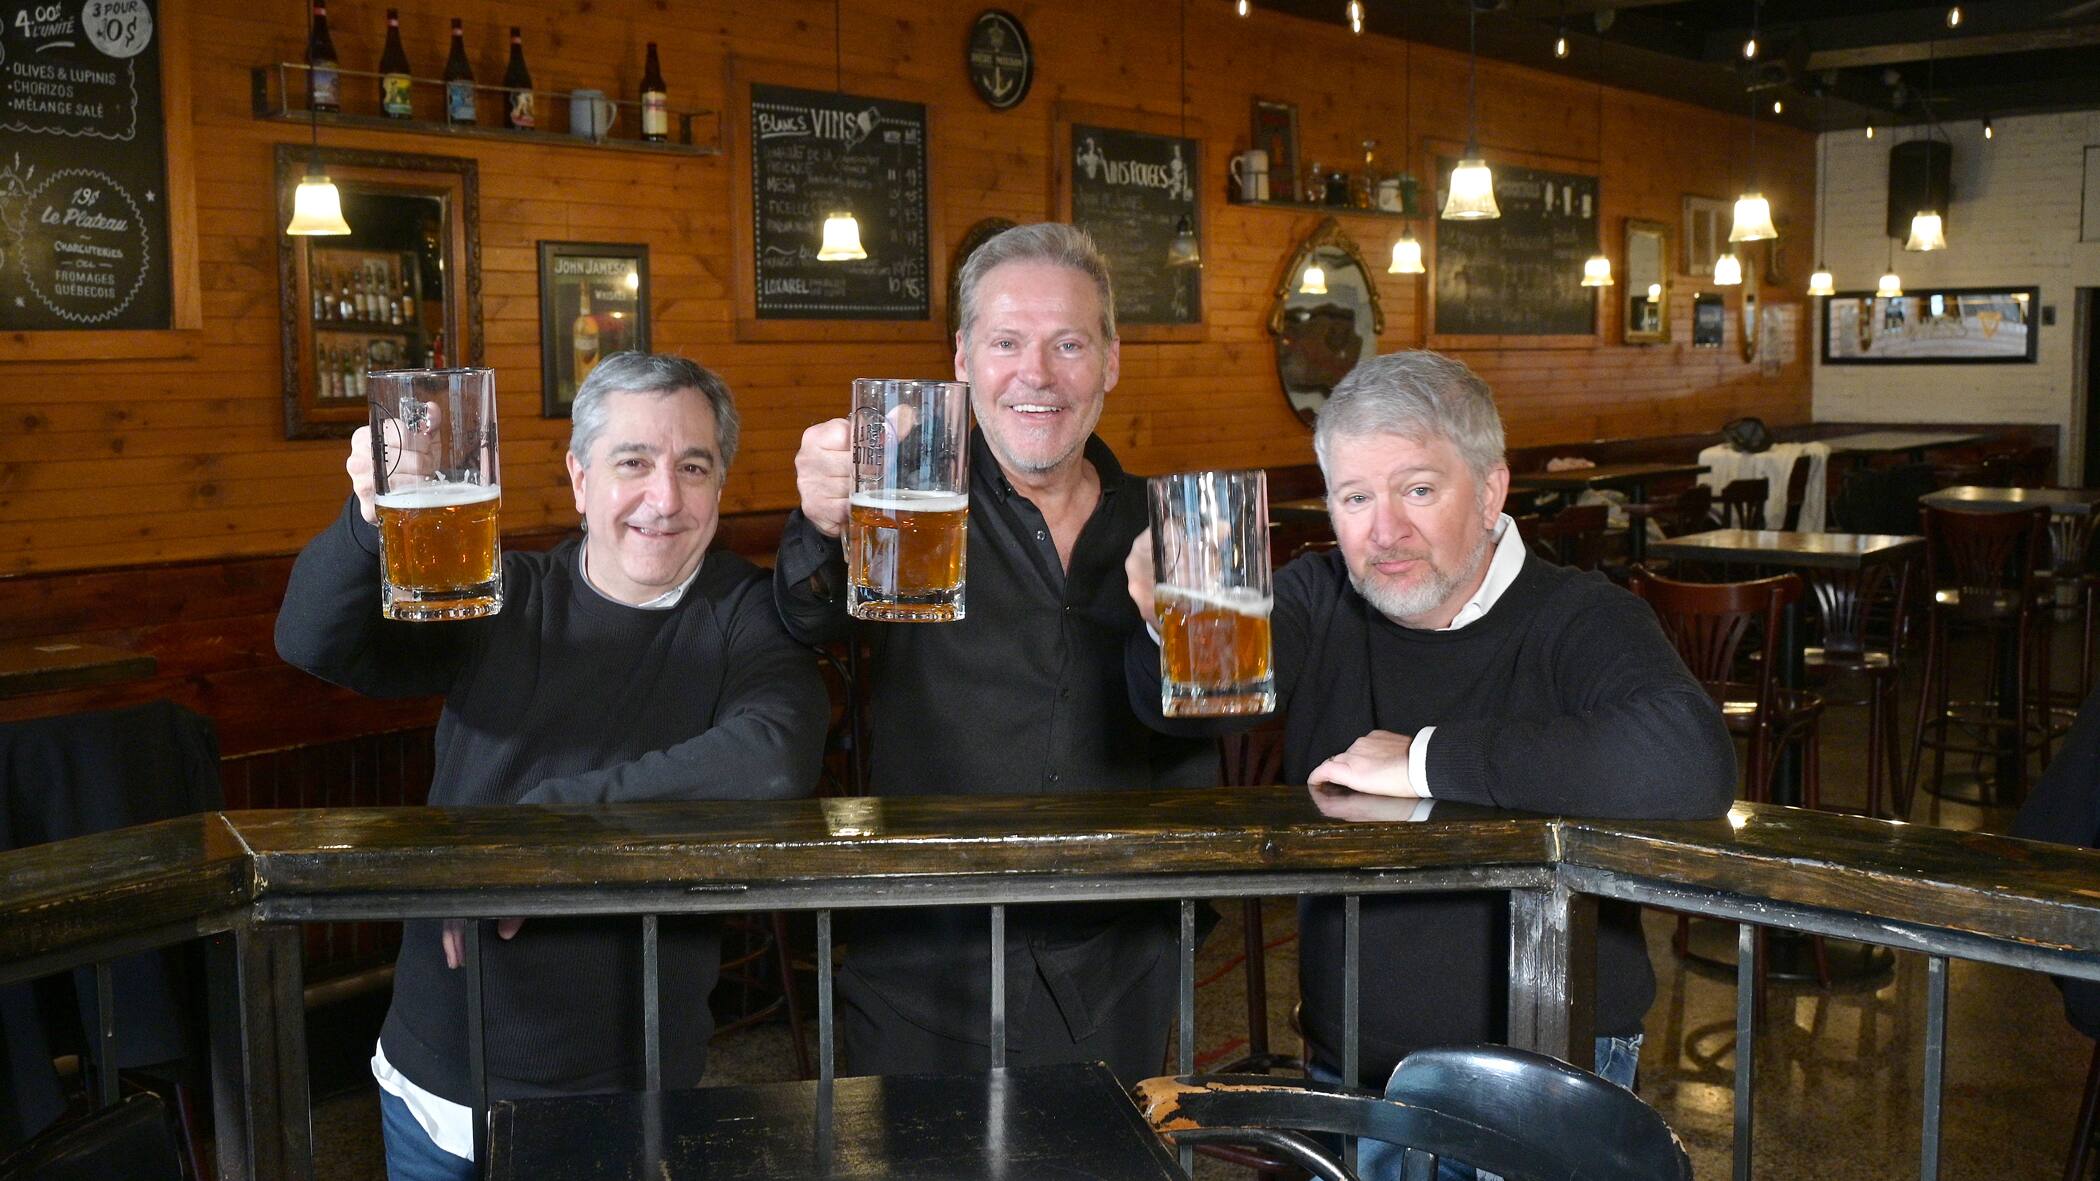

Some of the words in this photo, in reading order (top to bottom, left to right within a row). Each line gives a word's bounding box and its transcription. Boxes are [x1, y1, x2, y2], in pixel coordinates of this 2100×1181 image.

[92, 2, 101, 17] 3
[104, 0, 137, 15] POUR
[13, 62, 54, 80] OLIVES
[57, 69, 67, 80] &
[70, 69, 117, 85] LUPINIS
[13, 82, 74, 98] CHORIZOS
[14, 98, 72, 114] MÉLANGE
[75, 104, 104, 118] SALÉ
[810, 108, 857, 140] VINS
[41, 206, 60, 224] Le
[63, 208, 128, 232] Plateau
[554, 259, 584, 274] JOHN
[585, 259, 629, 275] JAMESO
[55, 270, 115, 285] FROMAGES
